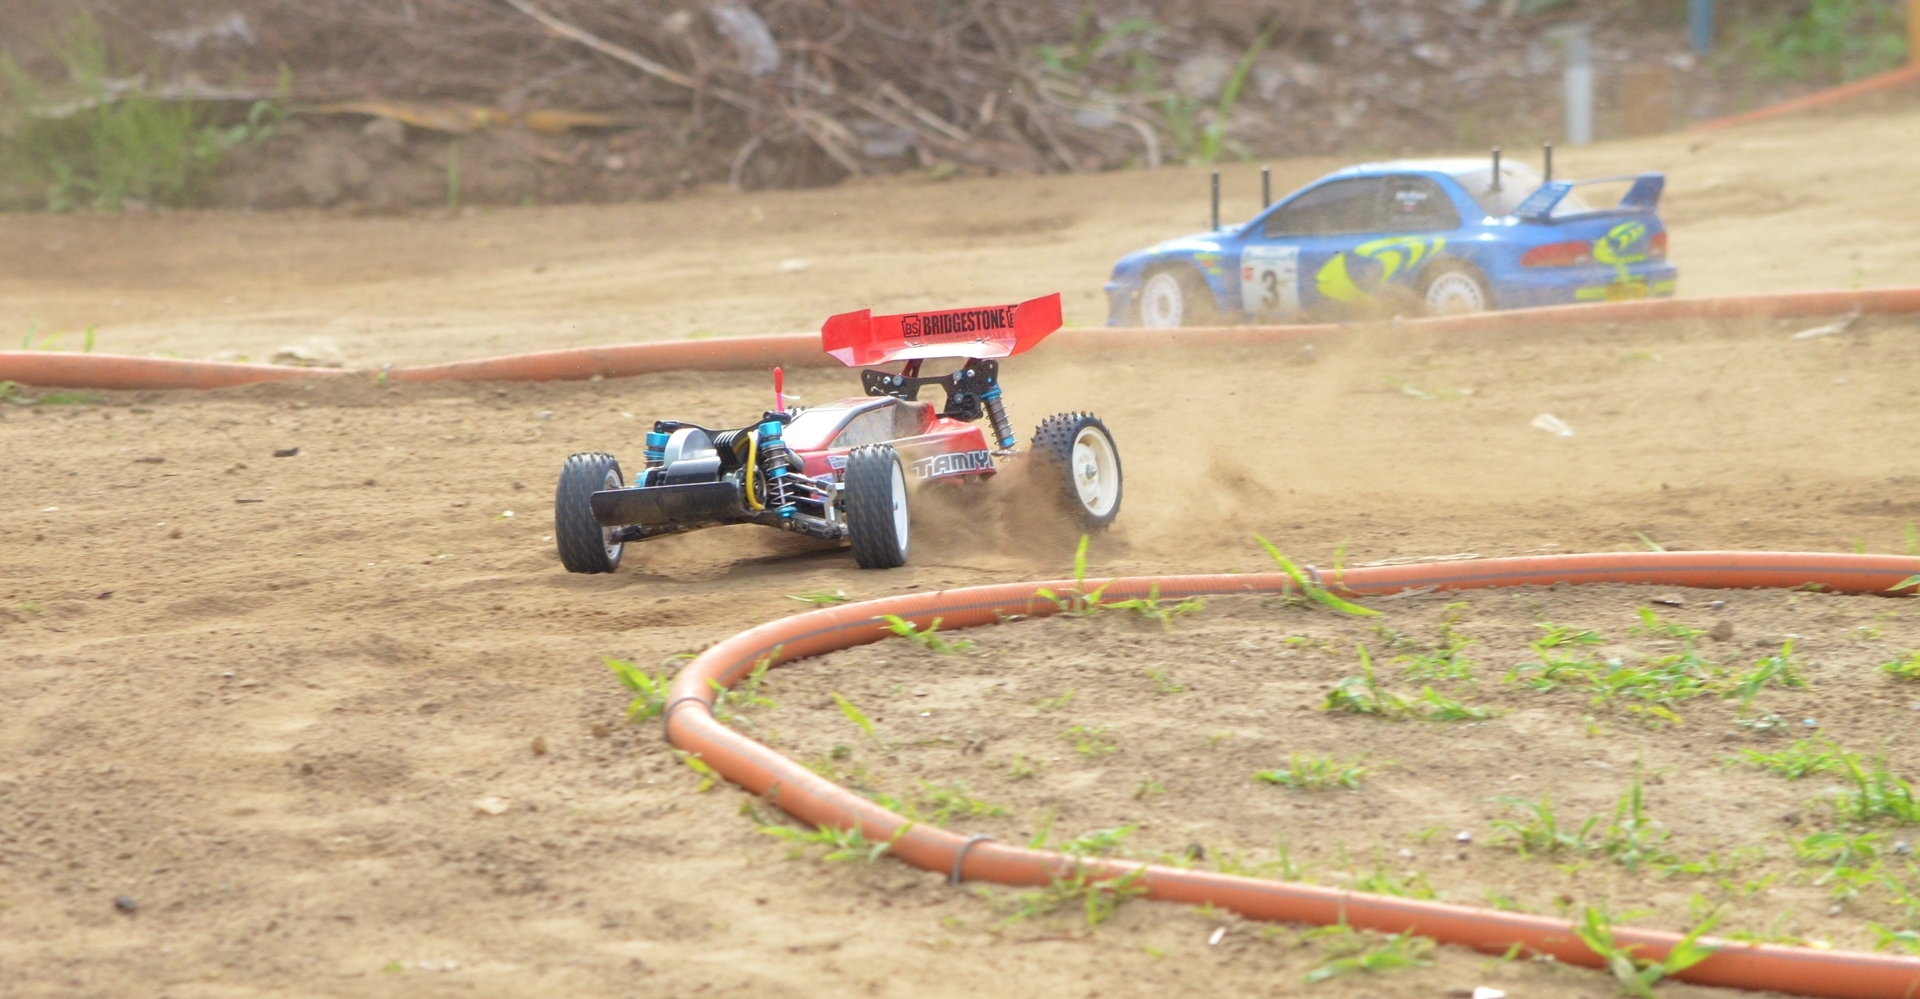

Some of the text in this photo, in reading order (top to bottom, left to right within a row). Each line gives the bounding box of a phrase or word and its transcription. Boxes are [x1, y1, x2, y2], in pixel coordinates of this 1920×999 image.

[1261, 269, 1279, 308] 3
[905, 322, 919, 335] BS
[922, 309, 1006, 336] BRIDGESTONE
